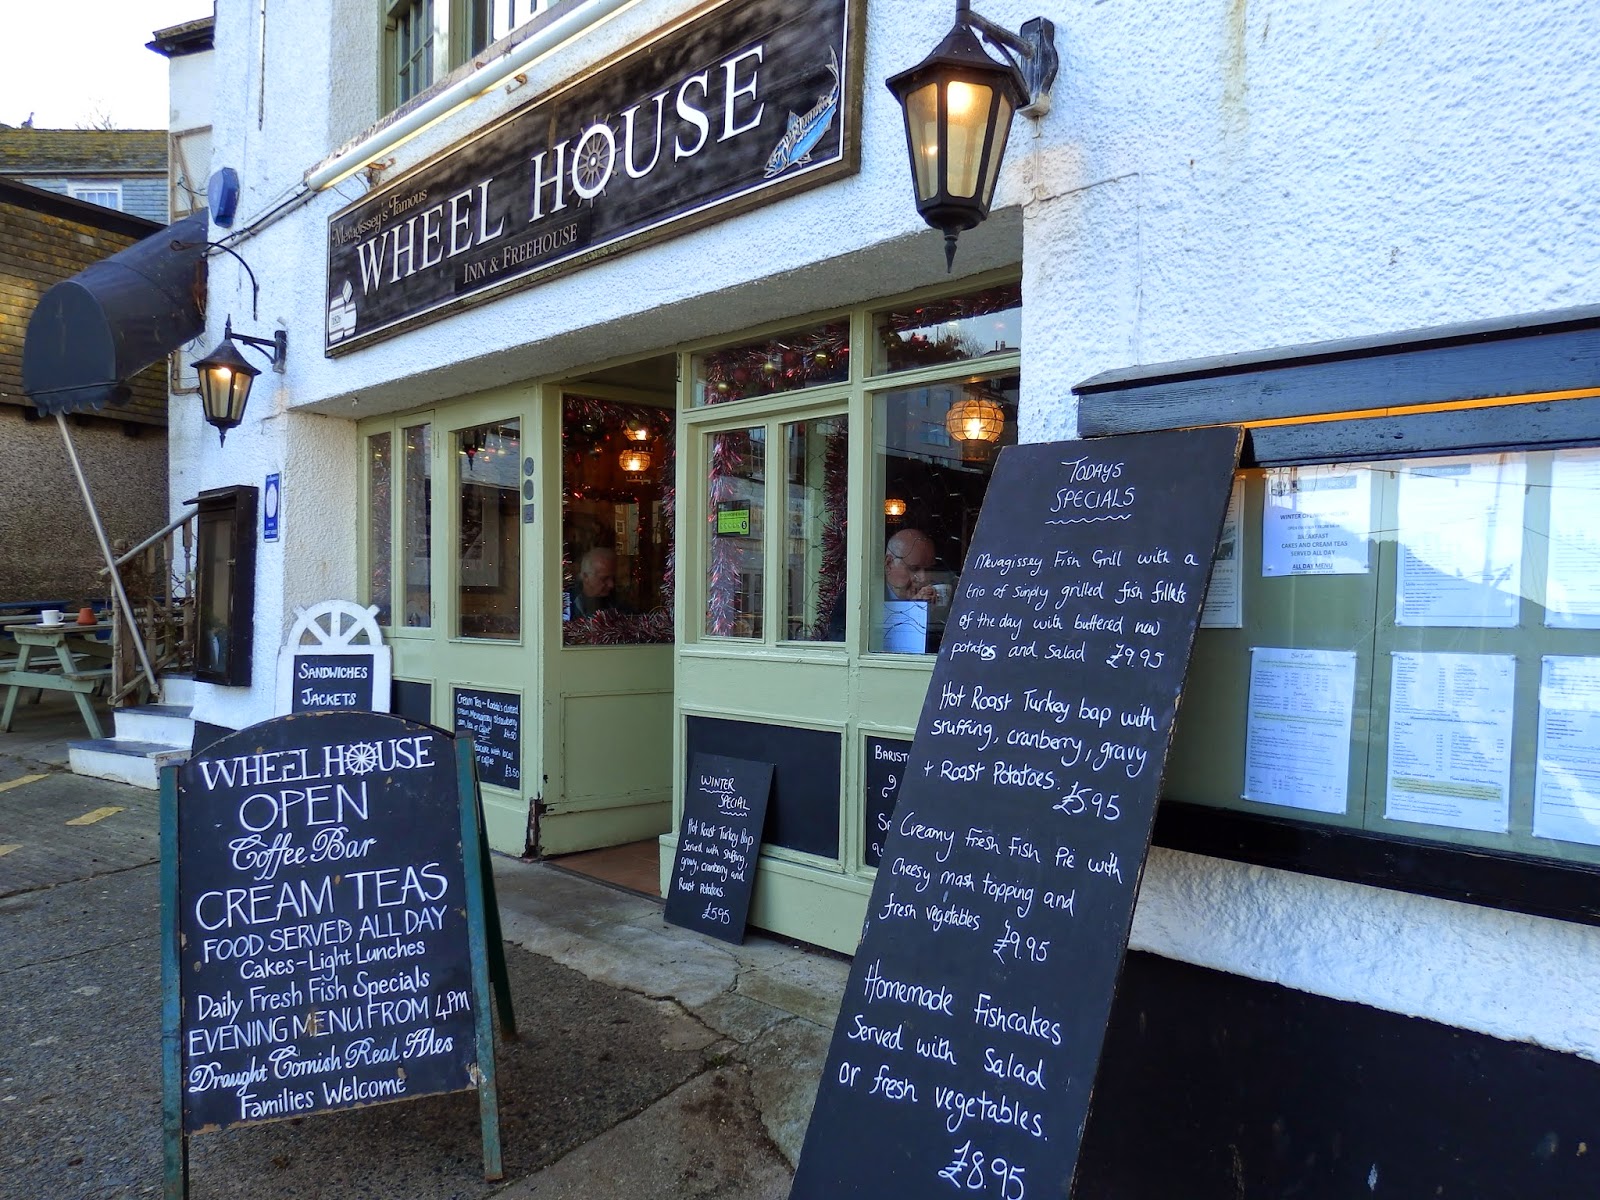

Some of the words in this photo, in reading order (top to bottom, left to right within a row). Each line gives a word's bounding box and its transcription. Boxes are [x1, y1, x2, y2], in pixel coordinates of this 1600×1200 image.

[356, 178, 505, 296] WHEEL
[529, 45, 765, 223] HOUSE
[332, 203, 388, 248] Mevagissey's
[389, 189, 427, 215] Famous
[463, 259, 486, 284] INN
[490, 257, 499, 272] &
[503, 223, 577, 269] FREEHOUSE
[1061, 456, 1124, 483] TODAYS
[1050, 487, 1135, 512] SPECIALS
[974, 554, 1043, 576] Mevagissey
[1054, 551, 1080, 568] Fish
[1092, 549, 1121, 568] Grill
[1137, 547, 1169, 565] with
[1184, 553, 1199, 566] a
[966, 584, 985, 599] trio
[993, 585, 1007, 600] of
[1055, 582, 1102, 610] grilled
[1115, 582, 1143, 604] fish
[959, 611, 975, 629] of
[977, 612, 994, 628] the
[999, 613, 1022, 640] day
[1033, 614, 1063, 630] with
[1074, 614, 1123, 634] buttered
[299, 663, 368, 679] SANDWICHES
[1008, 641, 1036, 658] and
[1106, 644, 1164, 668] £9.95
[302, 688, 356, 706] JACKETS
[939, 681, 966, 712] Hot
[972, 685, 1012, 712] Roast
[1023, 689, 1070, 723] Turkey
[1079, 698, 1111, 728] bap
[1120, 704, 1156, 731] with
[701, 775, 735, 791] WINTER
[1092, 740, 1147, 778] gravy
[239, 781, 369, 832] OPEN
[718, 794, 750, 810] SPECIAL
[940, 760, 985, 782] Roast
[1053, 782, 1120, 821] £5.95
[229, 833, 308, 881] Coffee
[310, 827, 377, 862] Bar
[683, 840, 702, 852] Served
[706, 844, 719, 856] with
[688, 818, 698, 835] Hot
[701, 822, 716, 838] Roast
[719, 826, 738, 847] Turkey
[741, 828, 753, 852] Bap
[900, 812, 955, 862] Creamy
[1008, 837, 1041, 863] Fish
[1055, 847, 1074, 868] Pie
[1088, 853, 1122, 884] with
[195, 876, 334, 931] CREAM
[345, 863, 448, 910] TEAS
[679, 877, 695, 891] Roast
[701, 863, 728, 882] cranberry
[731, 871, 744, 881] and
[891, 858, 930, 892] Cheesy
[983, 873, 1034, 918] topping
[1044, 889, 1074, 916] and
[204, 935, 264, 963] FOOD
[268, 920, 352, 952] SERVED
[359, 913, 402, 941] ALL
[405, 905, 447, 935] DAY
[356, 938, 425, 964] Lunches
[879, 893, 917, 920] fresh
[926, 902, 981, 931] vegetables
[993, 919, 1050, 963] £9.95
[198, 991, 244, 1025] Daily
[250, 982, 302, 1013] Fresh
[309, 976, 347, 1003] Fish
[353, 965, 431, 1005] Specials
[864, 959, 953, 1016] Homemade
[974, 993, 1061, 1045] Fishcakes
[188, 1016, 288, 1057] EVENING
[293, 1006, 363, 1039] MENU
[367, 996, 429, 1032] FROM
[188, 1056, 268, 1097] Draught
[269, 1046, 342, 1079] Cornish
[345, 1037, 399, 1068] Real
[402, 1027, 454, 1059] Ales
[848, 1014, 903, 1050] Served
[917, 1036, 956, 1065] with
[985, 1048, 1046, 1090] Salad
[241, 1088, 314, 1119] Families
[322, 1077, 406, 1105] Welcome
[838, 1062, 860, 1087] or
[869, 1065, 918, 1102] fresh
[935, 1087, 1048, 1141] vegetables.
[938, 1140, 1025, 1200] £8.95
